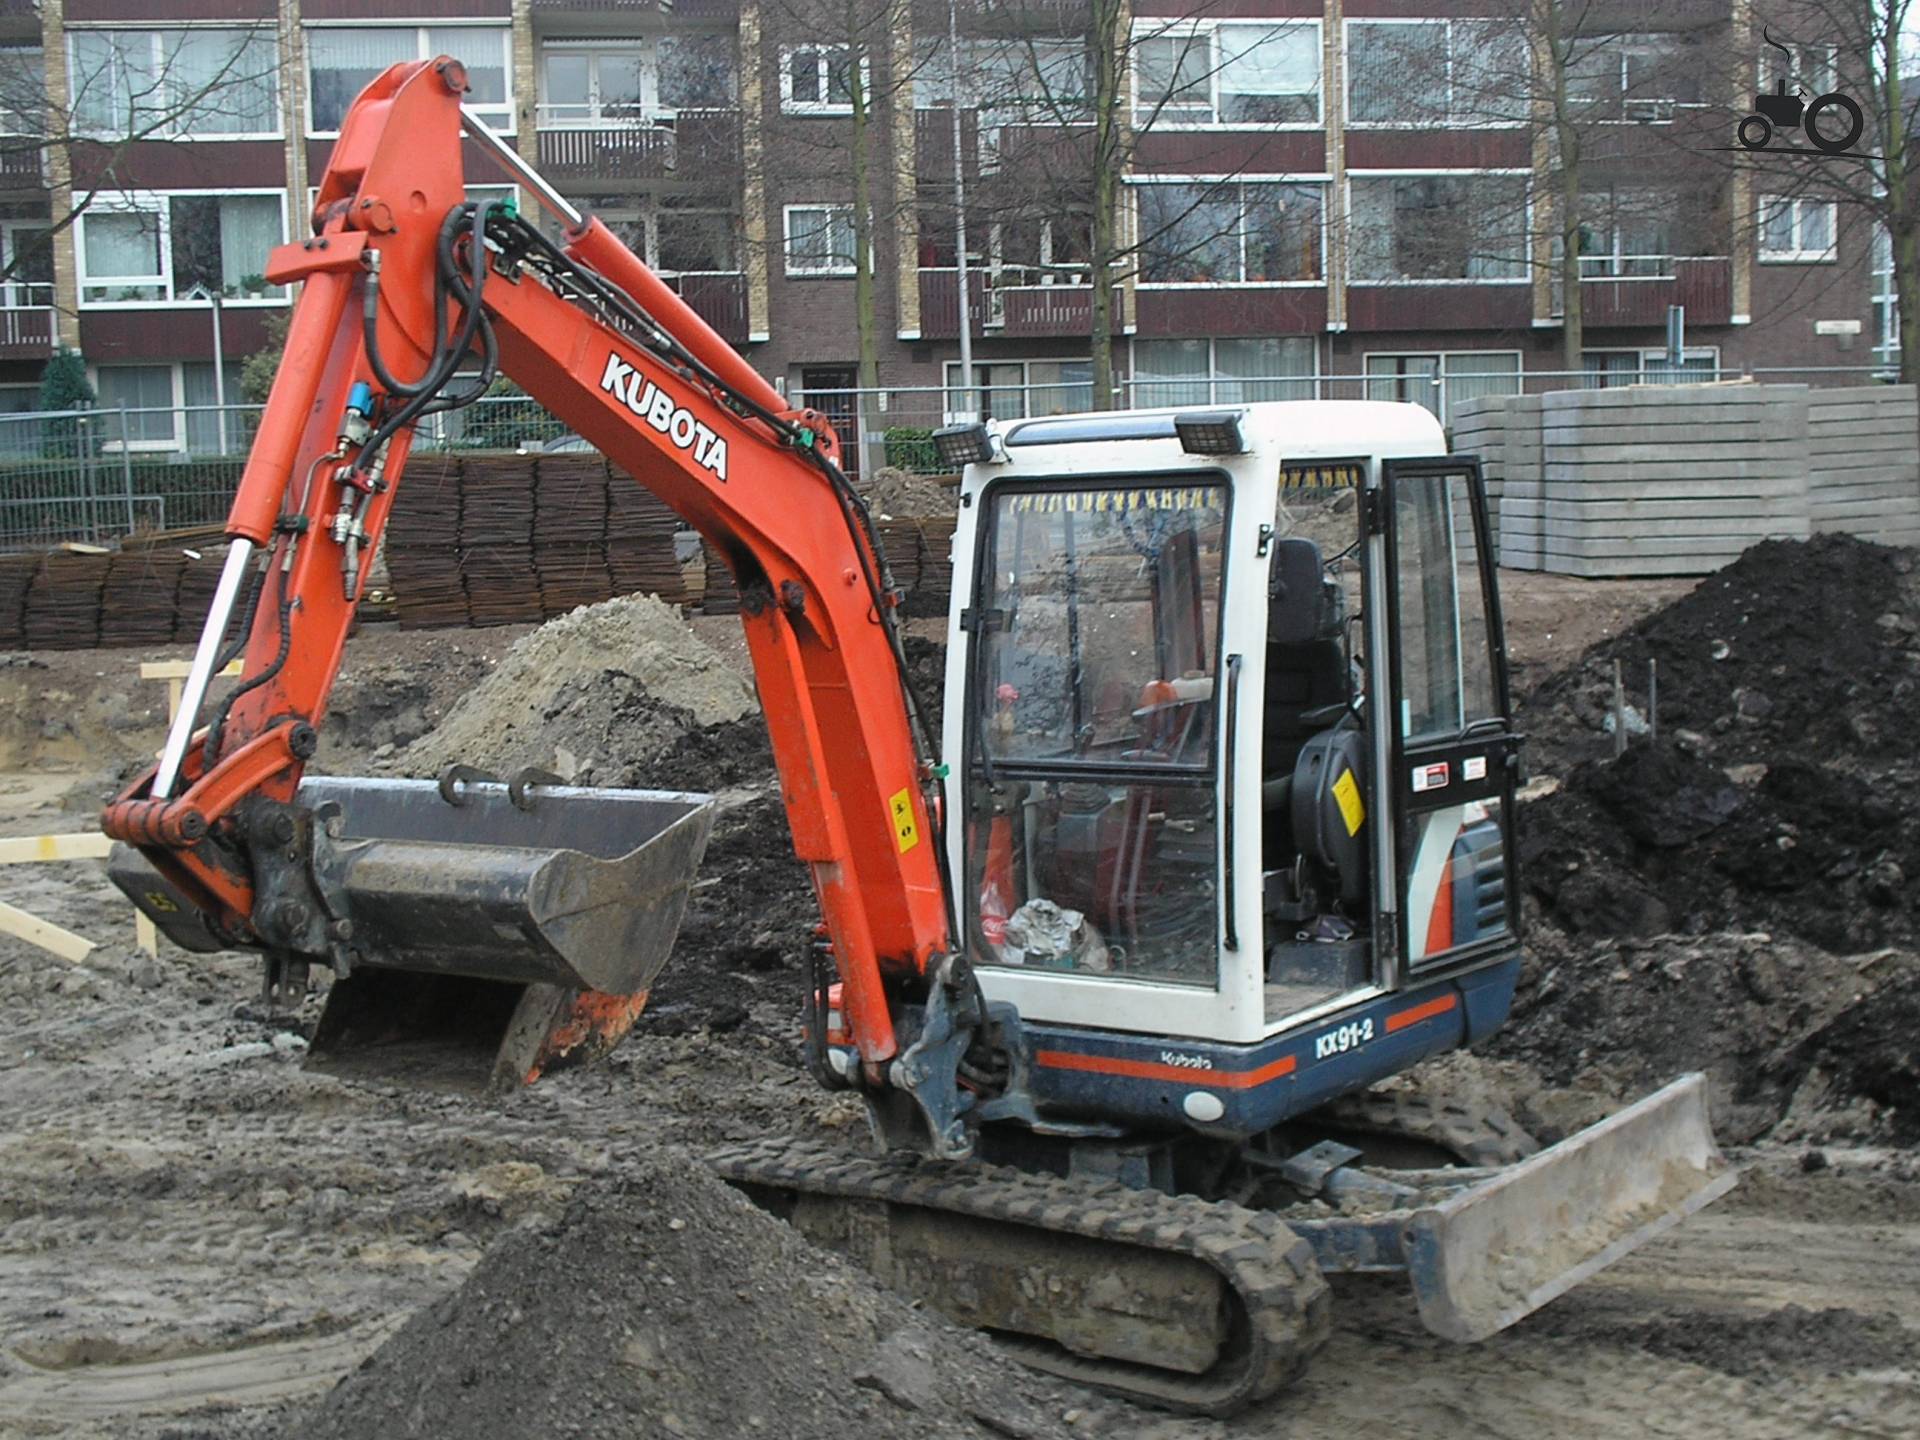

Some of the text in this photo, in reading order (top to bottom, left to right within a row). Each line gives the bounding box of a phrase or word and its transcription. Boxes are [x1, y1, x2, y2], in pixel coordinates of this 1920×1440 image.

[600, 351, 728, 482] KUBOTA
[1161, 1050, 1213, 1070] Kubota
[1315, 1017, 1375, 1060] KX91-2
